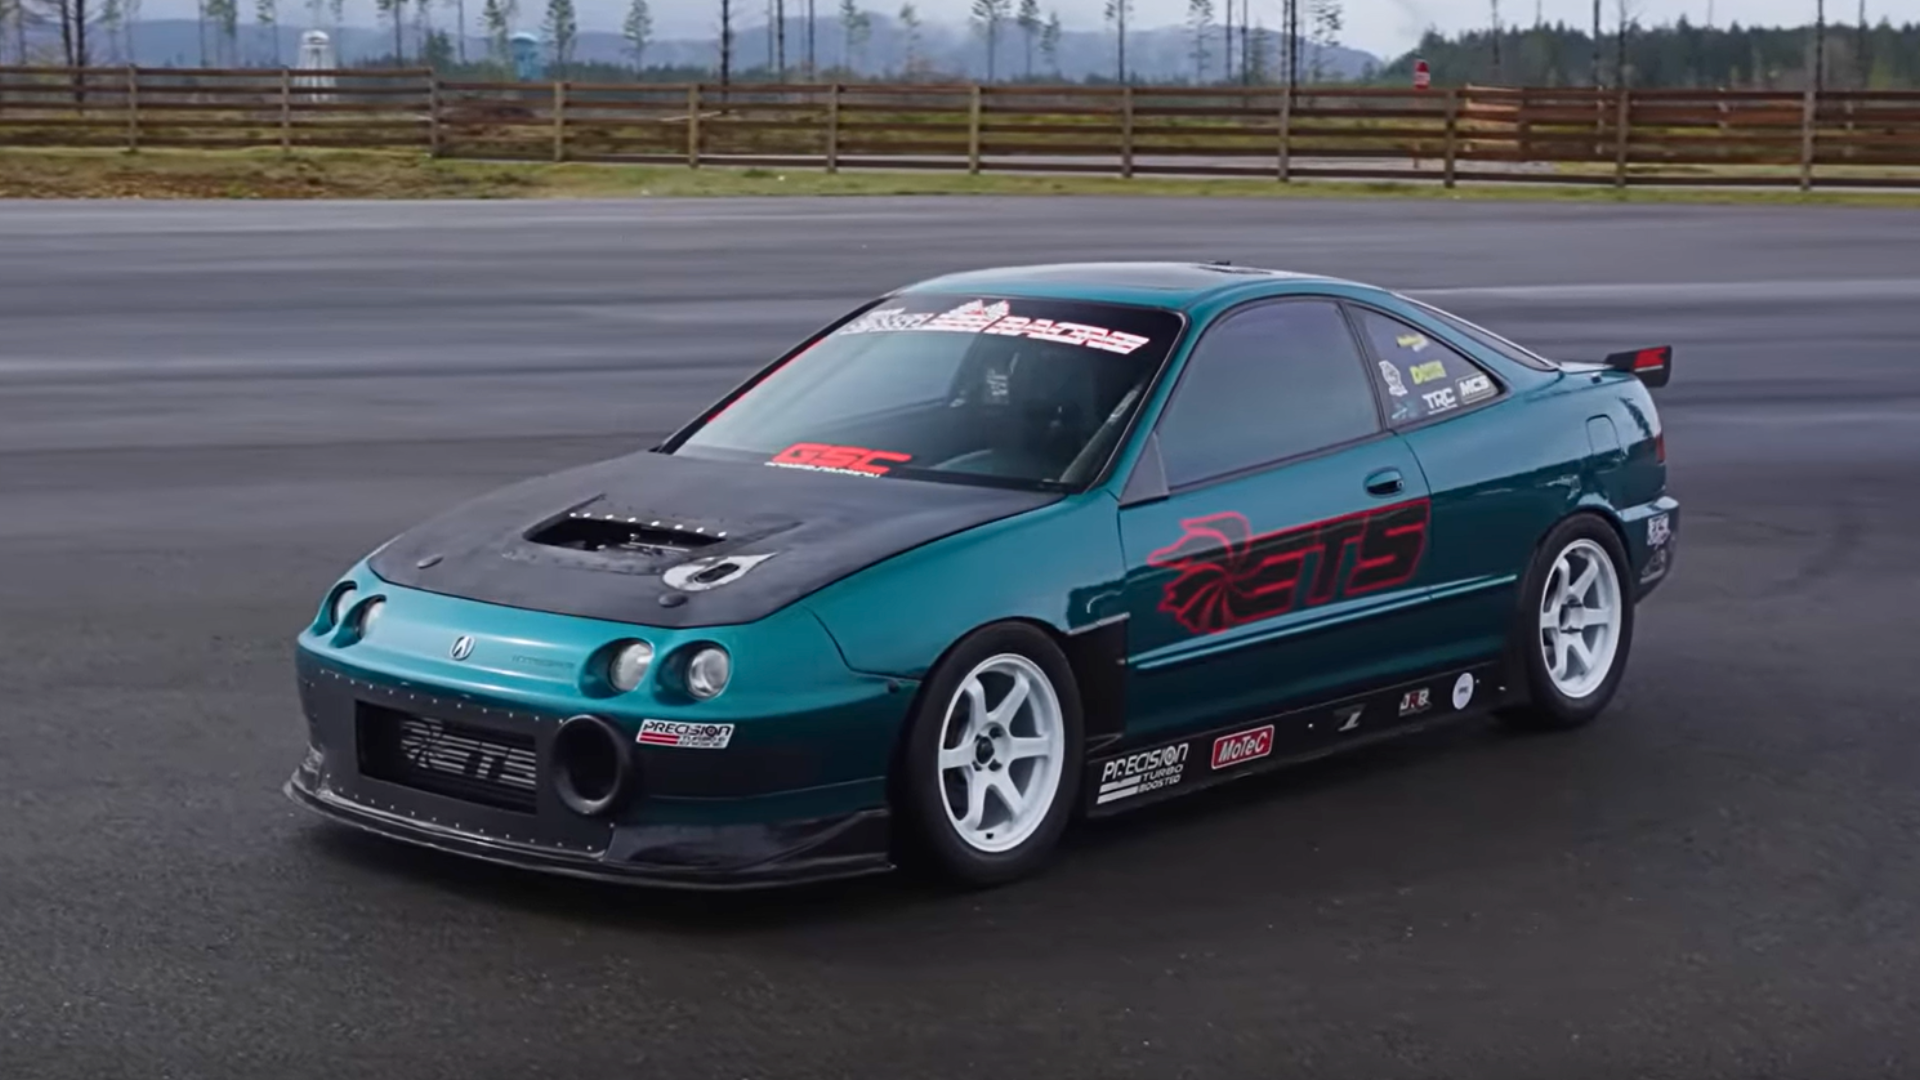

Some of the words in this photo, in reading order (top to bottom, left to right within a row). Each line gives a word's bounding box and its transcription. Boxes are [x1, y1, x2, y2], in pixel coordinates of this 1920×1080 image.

[1422, 387, 1456, 409] TRC
[1222, 498, 1431, 624] ETS
[643, 721, 732, 737] PRECISION
[1218, 731, 1268, 762] MoTeC
[1102, 743, 1189, 783] PRECISION
[1143, 764, 1184, 781] TURBO
